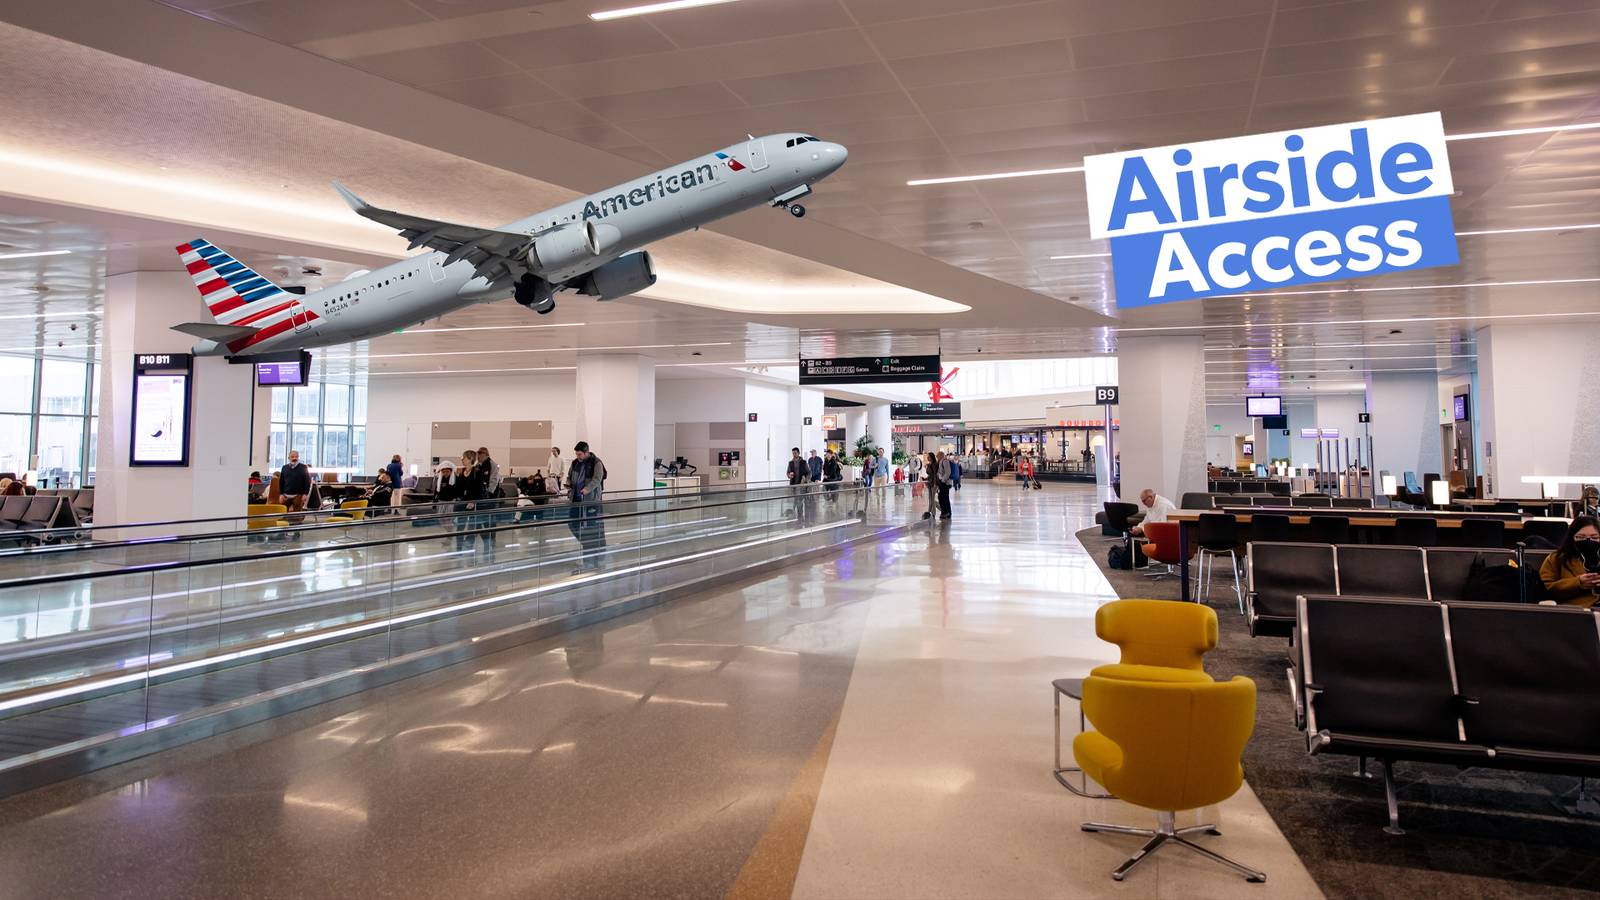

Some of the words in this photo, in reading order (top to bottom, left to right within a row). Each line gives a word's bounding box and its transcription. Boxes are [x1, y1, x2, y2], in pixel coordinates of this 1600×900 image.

[582, 163, 713, 221] American
[139, 355, 155, 364] B10
[156, 355, 170, 364] B11
[1098, 389, 1115, 401] B9
